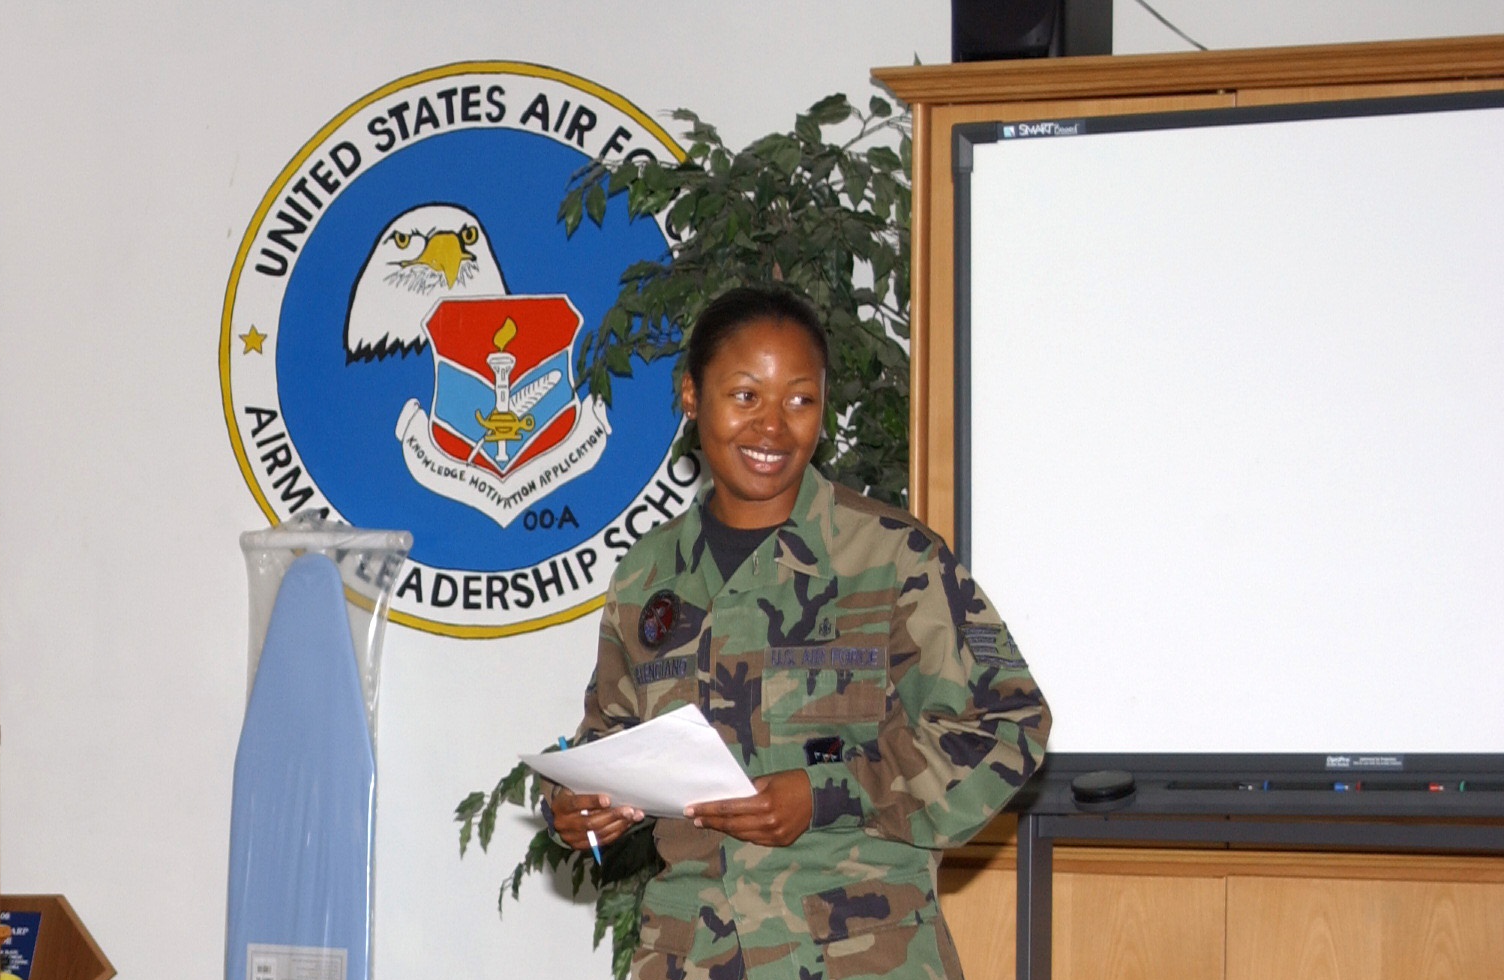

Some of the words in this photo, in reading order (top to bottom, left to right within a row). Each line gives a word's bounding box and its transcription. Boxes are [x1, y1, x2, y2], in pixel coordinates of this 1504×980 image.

[1019, 122, 1054, 136] SMART
[255, 141, 362, 277] UNITED
[367, 85, 506, 152] STATES
[520, 93, 597, 148] AIR
[406, 435, 466, 482] KNOWLEDGE
[469, 477, 537, 510] MOTIVATION
[540, 428, 604, 488] APPLICATION
[604, 450, 701, 562] SCHO
